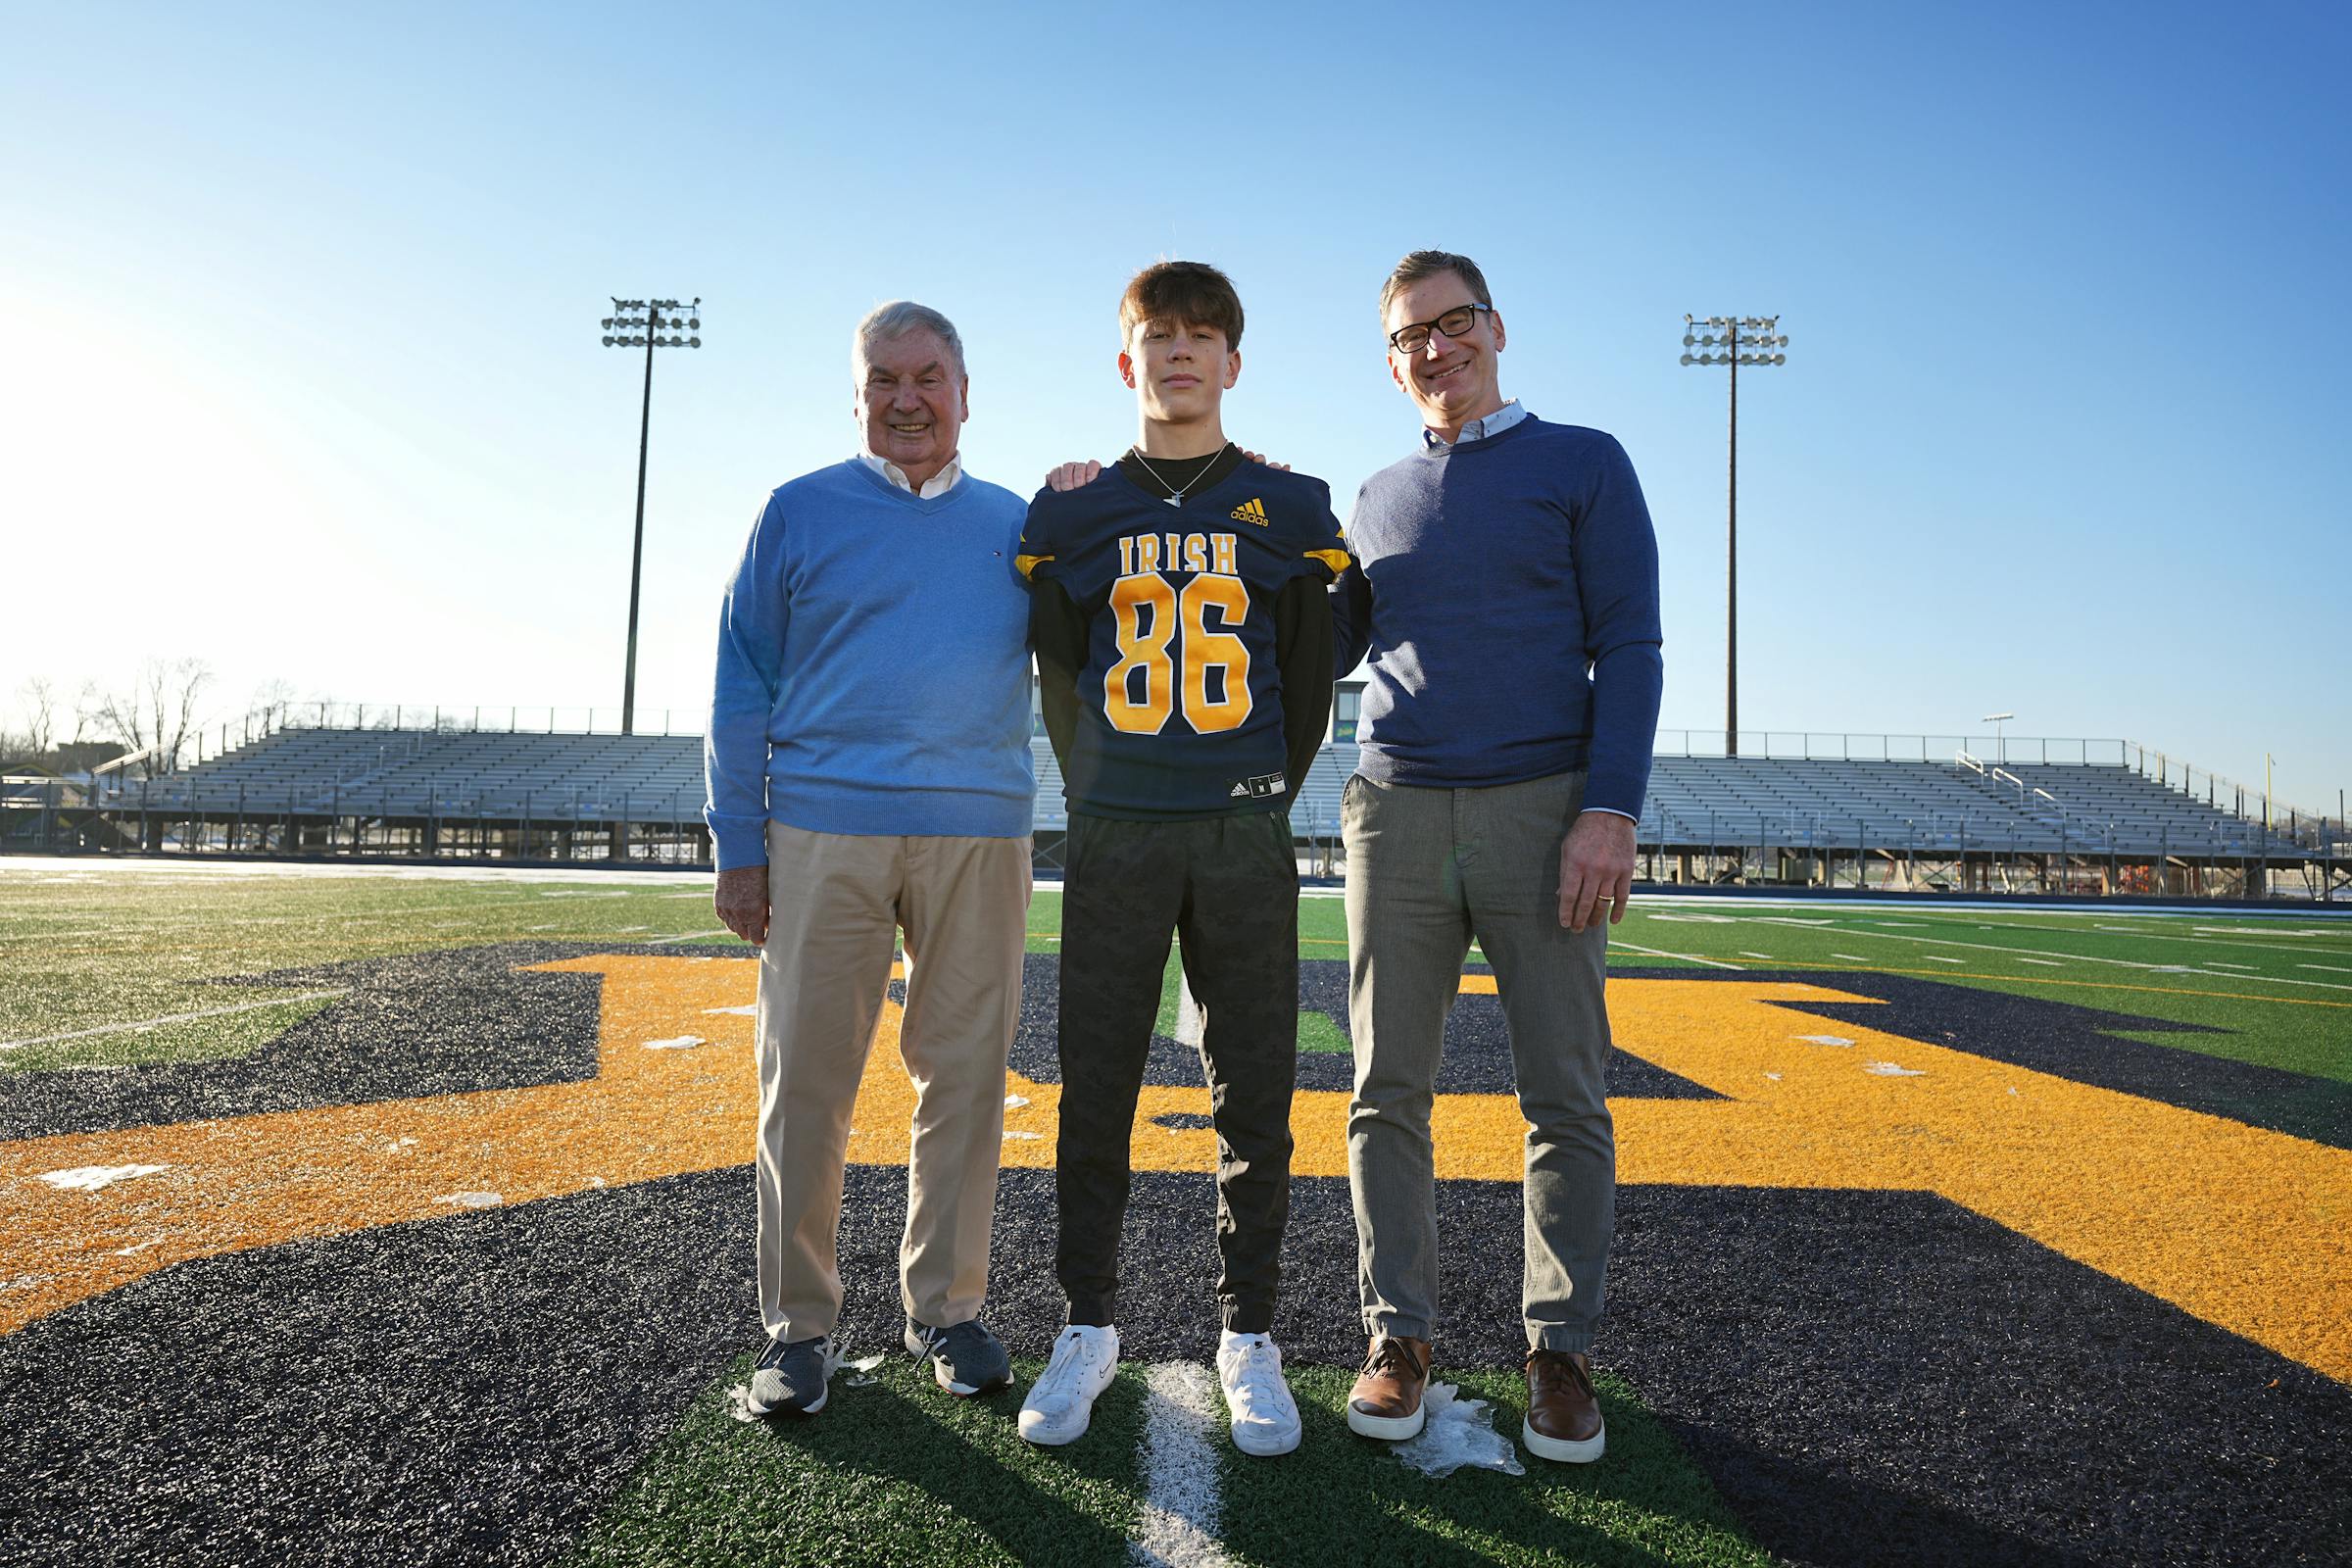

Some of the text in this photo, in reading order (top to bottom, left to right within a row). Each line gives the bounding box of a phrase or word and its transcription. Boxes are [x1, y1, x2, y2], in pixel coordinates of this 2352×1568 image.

[1230, 510, 1269, 527] adidas
[1118, 532, 1239, 575] IRISH
[1103, 571, 1253, 735] 86
